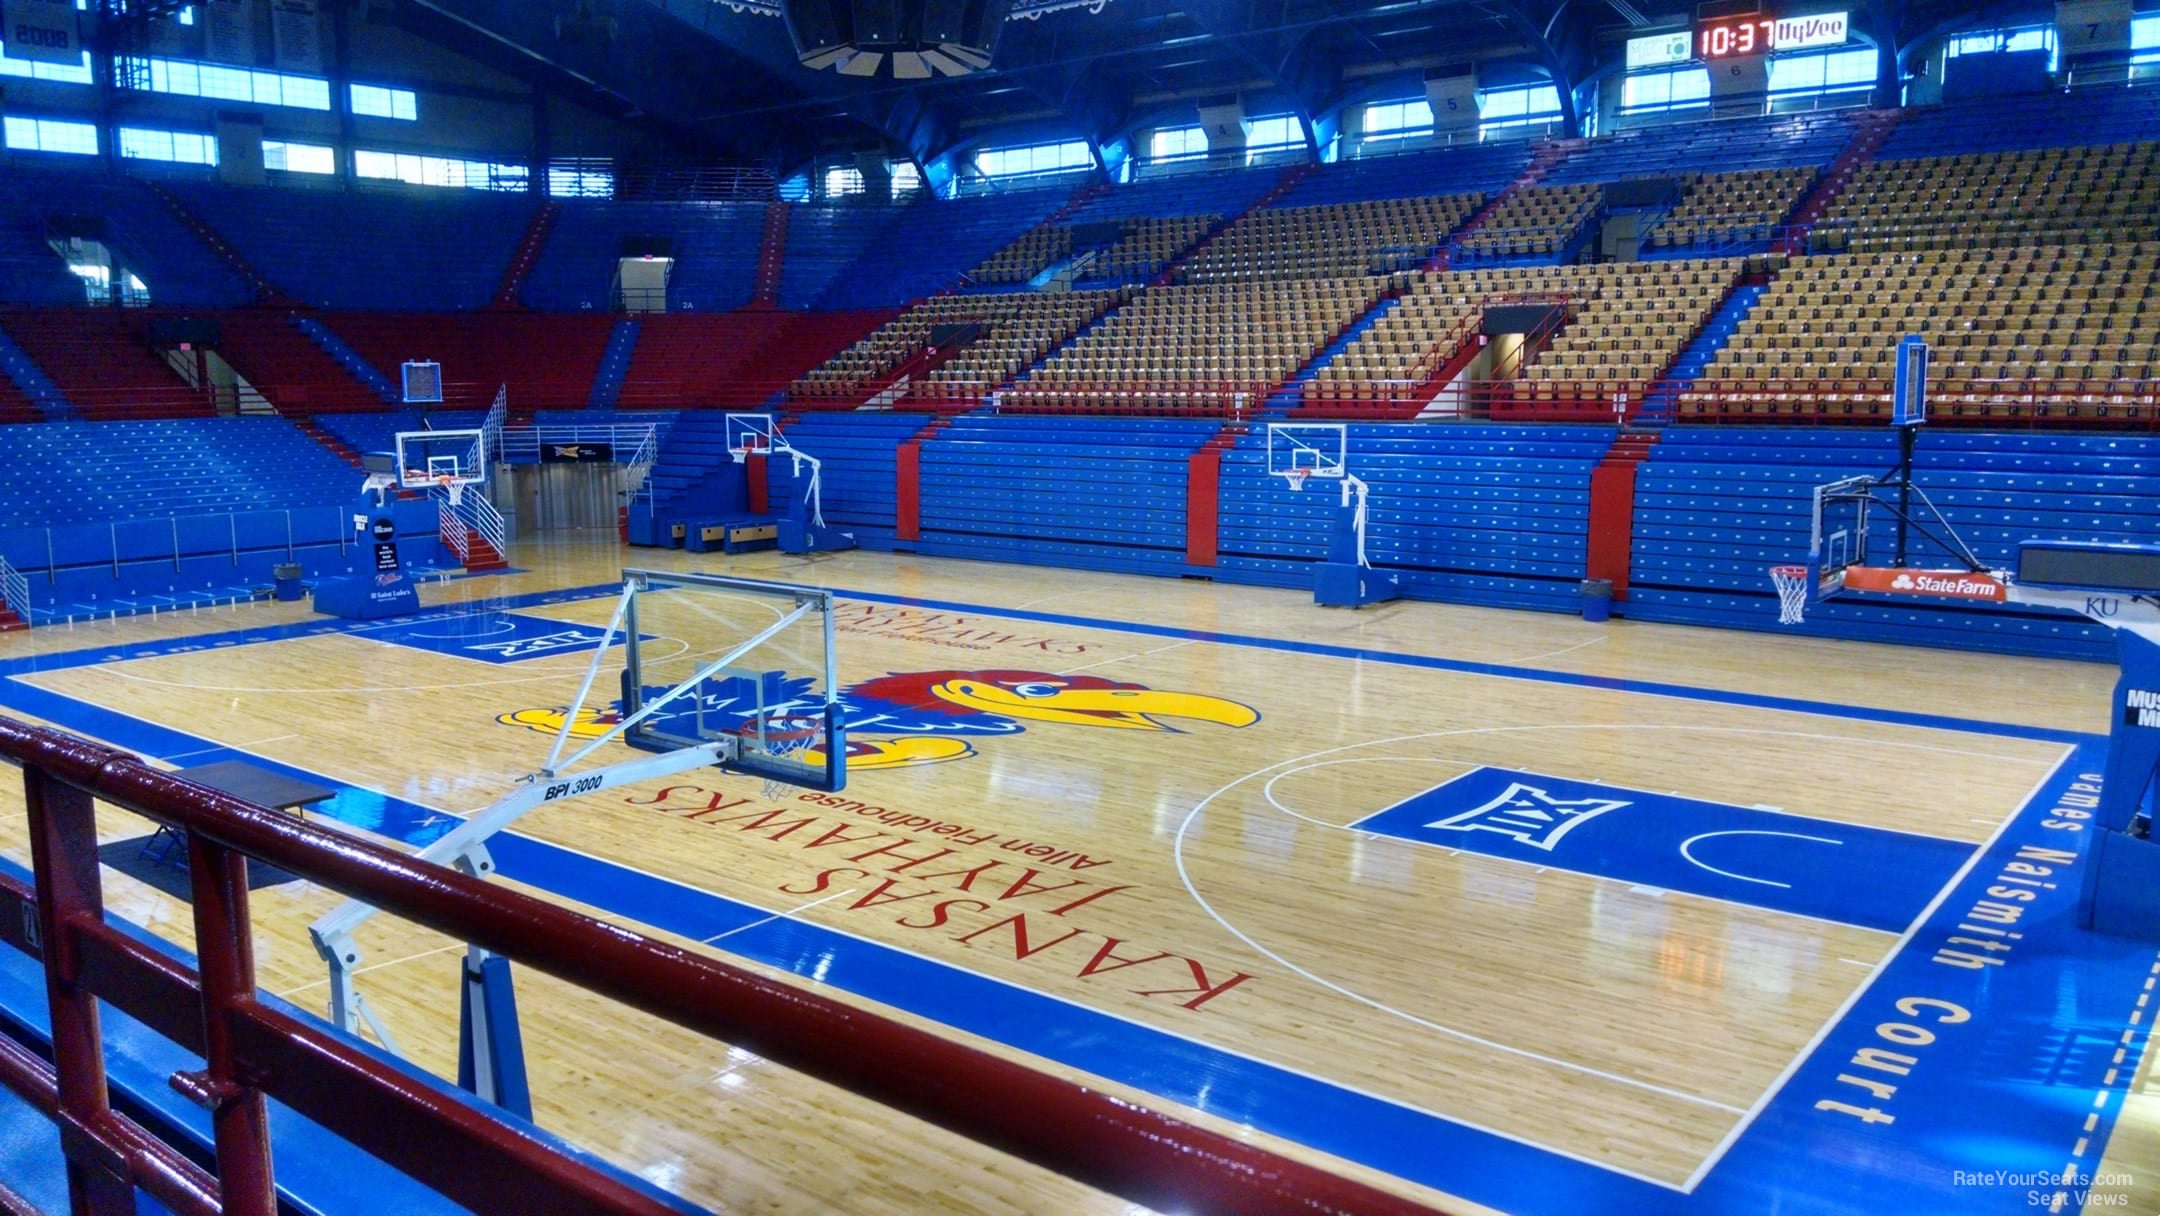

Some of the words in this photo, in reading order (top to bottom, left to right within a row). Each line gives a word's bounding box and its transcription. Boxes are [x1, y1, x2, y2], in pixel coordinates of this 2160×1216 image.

[1702, 21, 1774, 55] 10:37
[2088, 24, 2099, 39] 7
[1730, 65, 1741, 77] 6
[1447, 97, 1457, 110] 5
[2085, 597, 2120, 617] KU
[544, 783, 570, 801] BPI
[571, 774, 603, 795] 3000
[799, 791, 986, 846] Fieldhouse
[626, 784, 1137, 917] JAYHAWKS
[1001, 839, 1112, 867] Allen
[1931, 845, 2078, 969] Naismith
[779, 867, 1260, 1011] KANSAS
[1814, 997, 1972, 1124] Court
